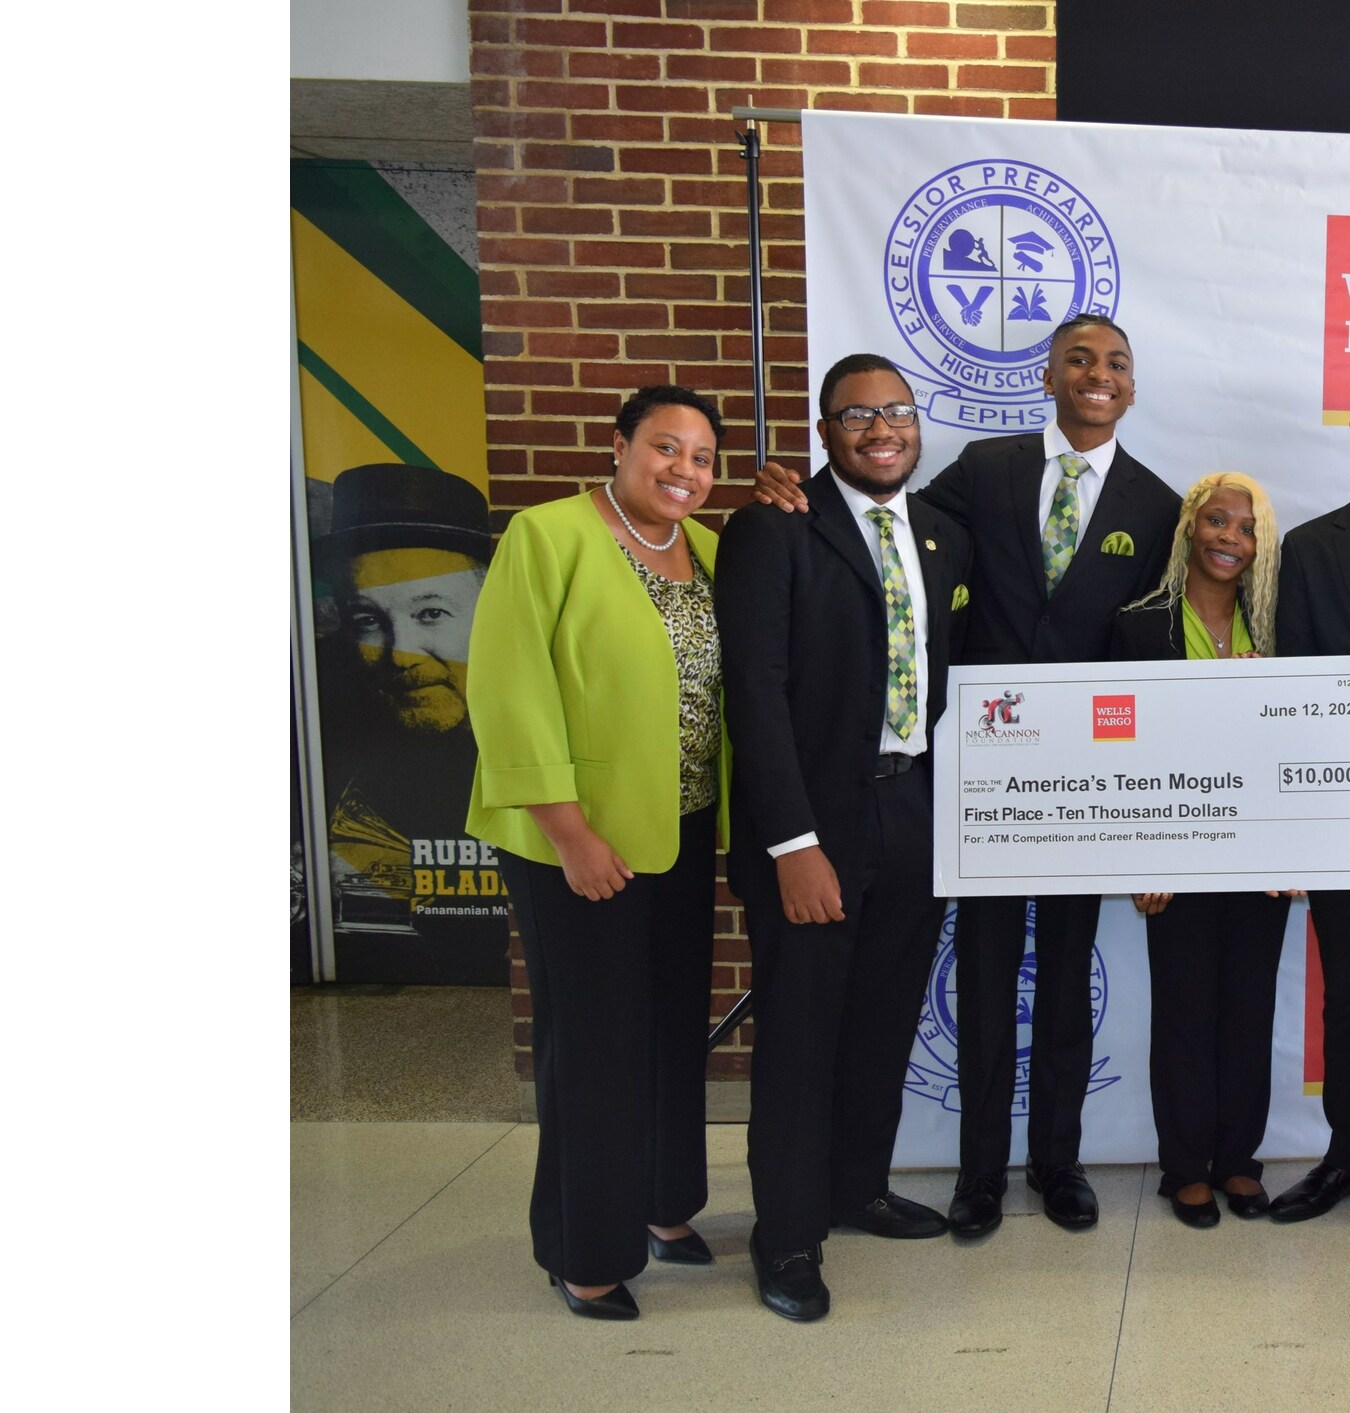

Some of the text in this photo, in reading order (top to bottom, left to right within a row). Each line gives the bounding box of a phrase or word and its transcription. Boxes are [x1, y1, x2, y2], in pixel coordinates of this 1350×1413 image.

[1026, 204, 1081, 263] ACHIEVEMENT
[891, 166, 1114, 336] EXCELSIOR PREPARATOR
[931, 313, 966, 349] SERVICE
[939, 353, 1045, 388] HIGH SCHO
[915, 388, 928, 399] EST
[957, 404, 1048, 426] EPHS
[1096, 707, 1131, 716] WELLS
[1260, 705, 1297, 717] June
[1302, 703, 1323, 718] 12,
[1097, 717, 1132, 726] FARGO
[994, 729, 1040, 738] CANNON
[1005, 772, 1243, 794] America's Teen Moguls
[964, 807, 999, 822] First
[1002, 807, 1044, 821] Place
[1056, 806, 1085, 820] Ten
[1088, 804, 1172, 819] Thousand
[1178, 803, 1238, 818] Dollars
[964, 830, 1236, 844] For: ATM Competition and Career Readiness Program
[412, 839, 499, 866] RUBE
[414, 869, 508, 896] BLAD
[416, 905, 489, 915] Panamanian
